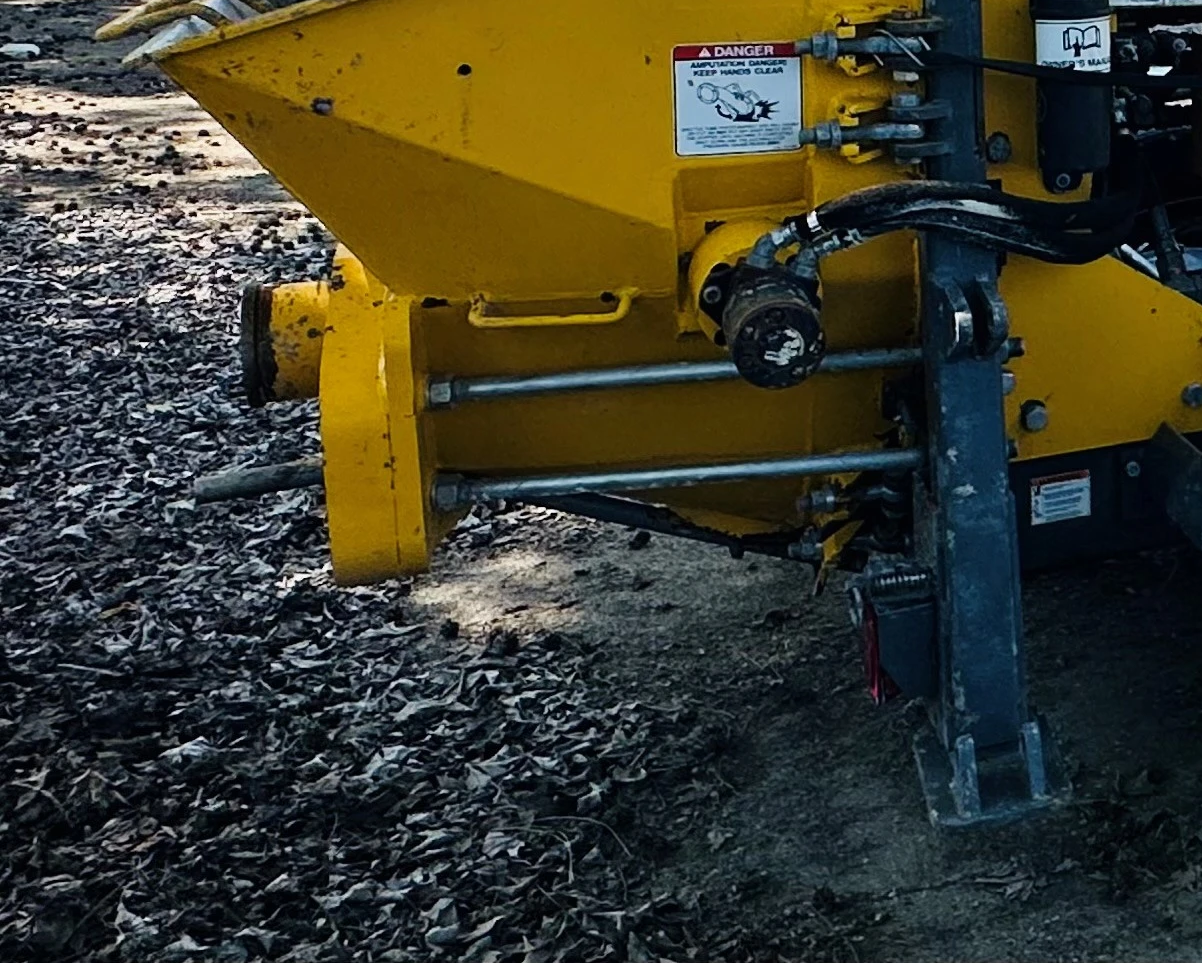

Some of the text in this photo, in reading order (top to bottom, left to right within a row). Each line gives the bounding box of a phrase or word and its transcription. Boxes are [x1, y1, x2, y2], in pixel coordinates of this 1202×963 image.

[714, 45, 774, 58] DANGER
[690, 60, 746, 69] AMPUTATION
[693, 67, 784, 77] KEEP HANDS CLEAR
